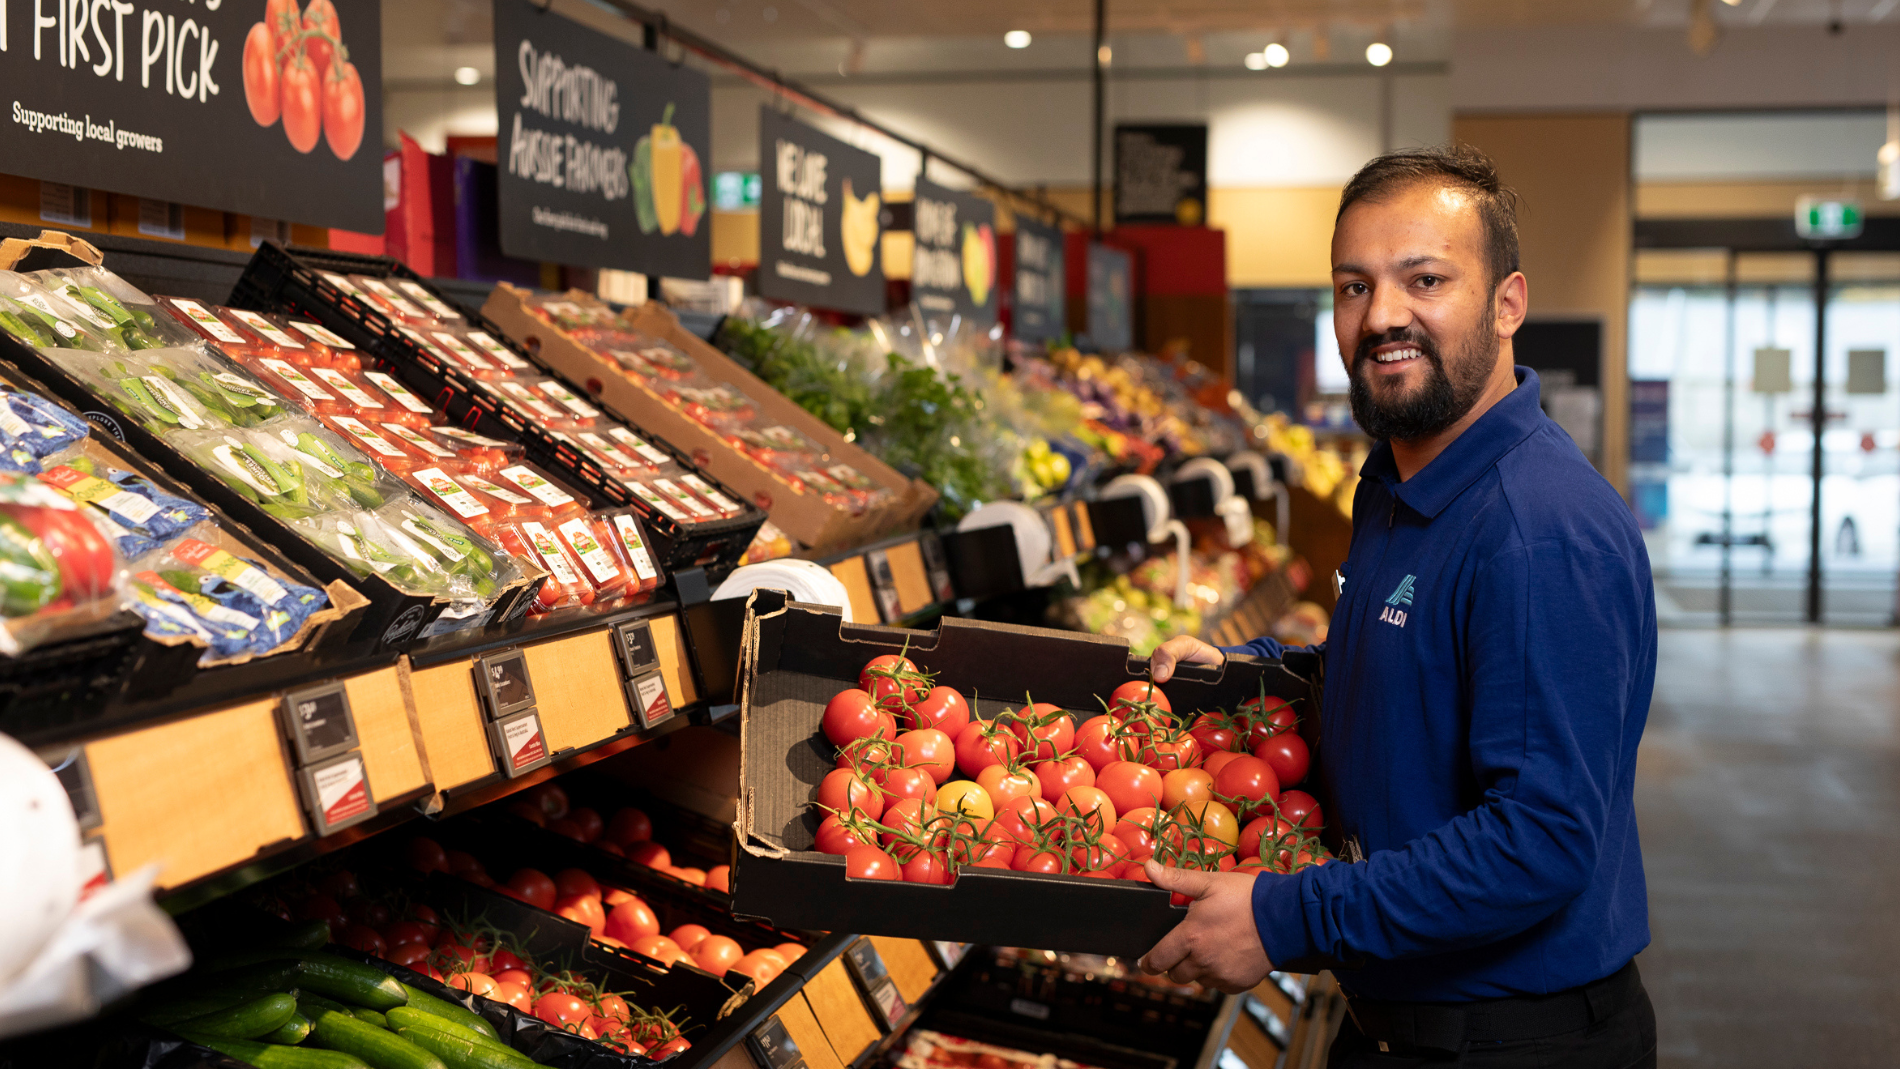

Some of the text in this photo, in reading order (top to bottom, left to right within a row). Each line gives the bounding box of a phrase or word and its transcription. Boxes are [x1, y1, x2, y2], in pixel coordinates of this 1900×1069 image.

[34, 0, 134, 82] FIRST
[142, 9, 220, 103] PICK
[12, 100, 163, 153] Supporting local growers
[1379, 606, 1407, 628] ALDI
